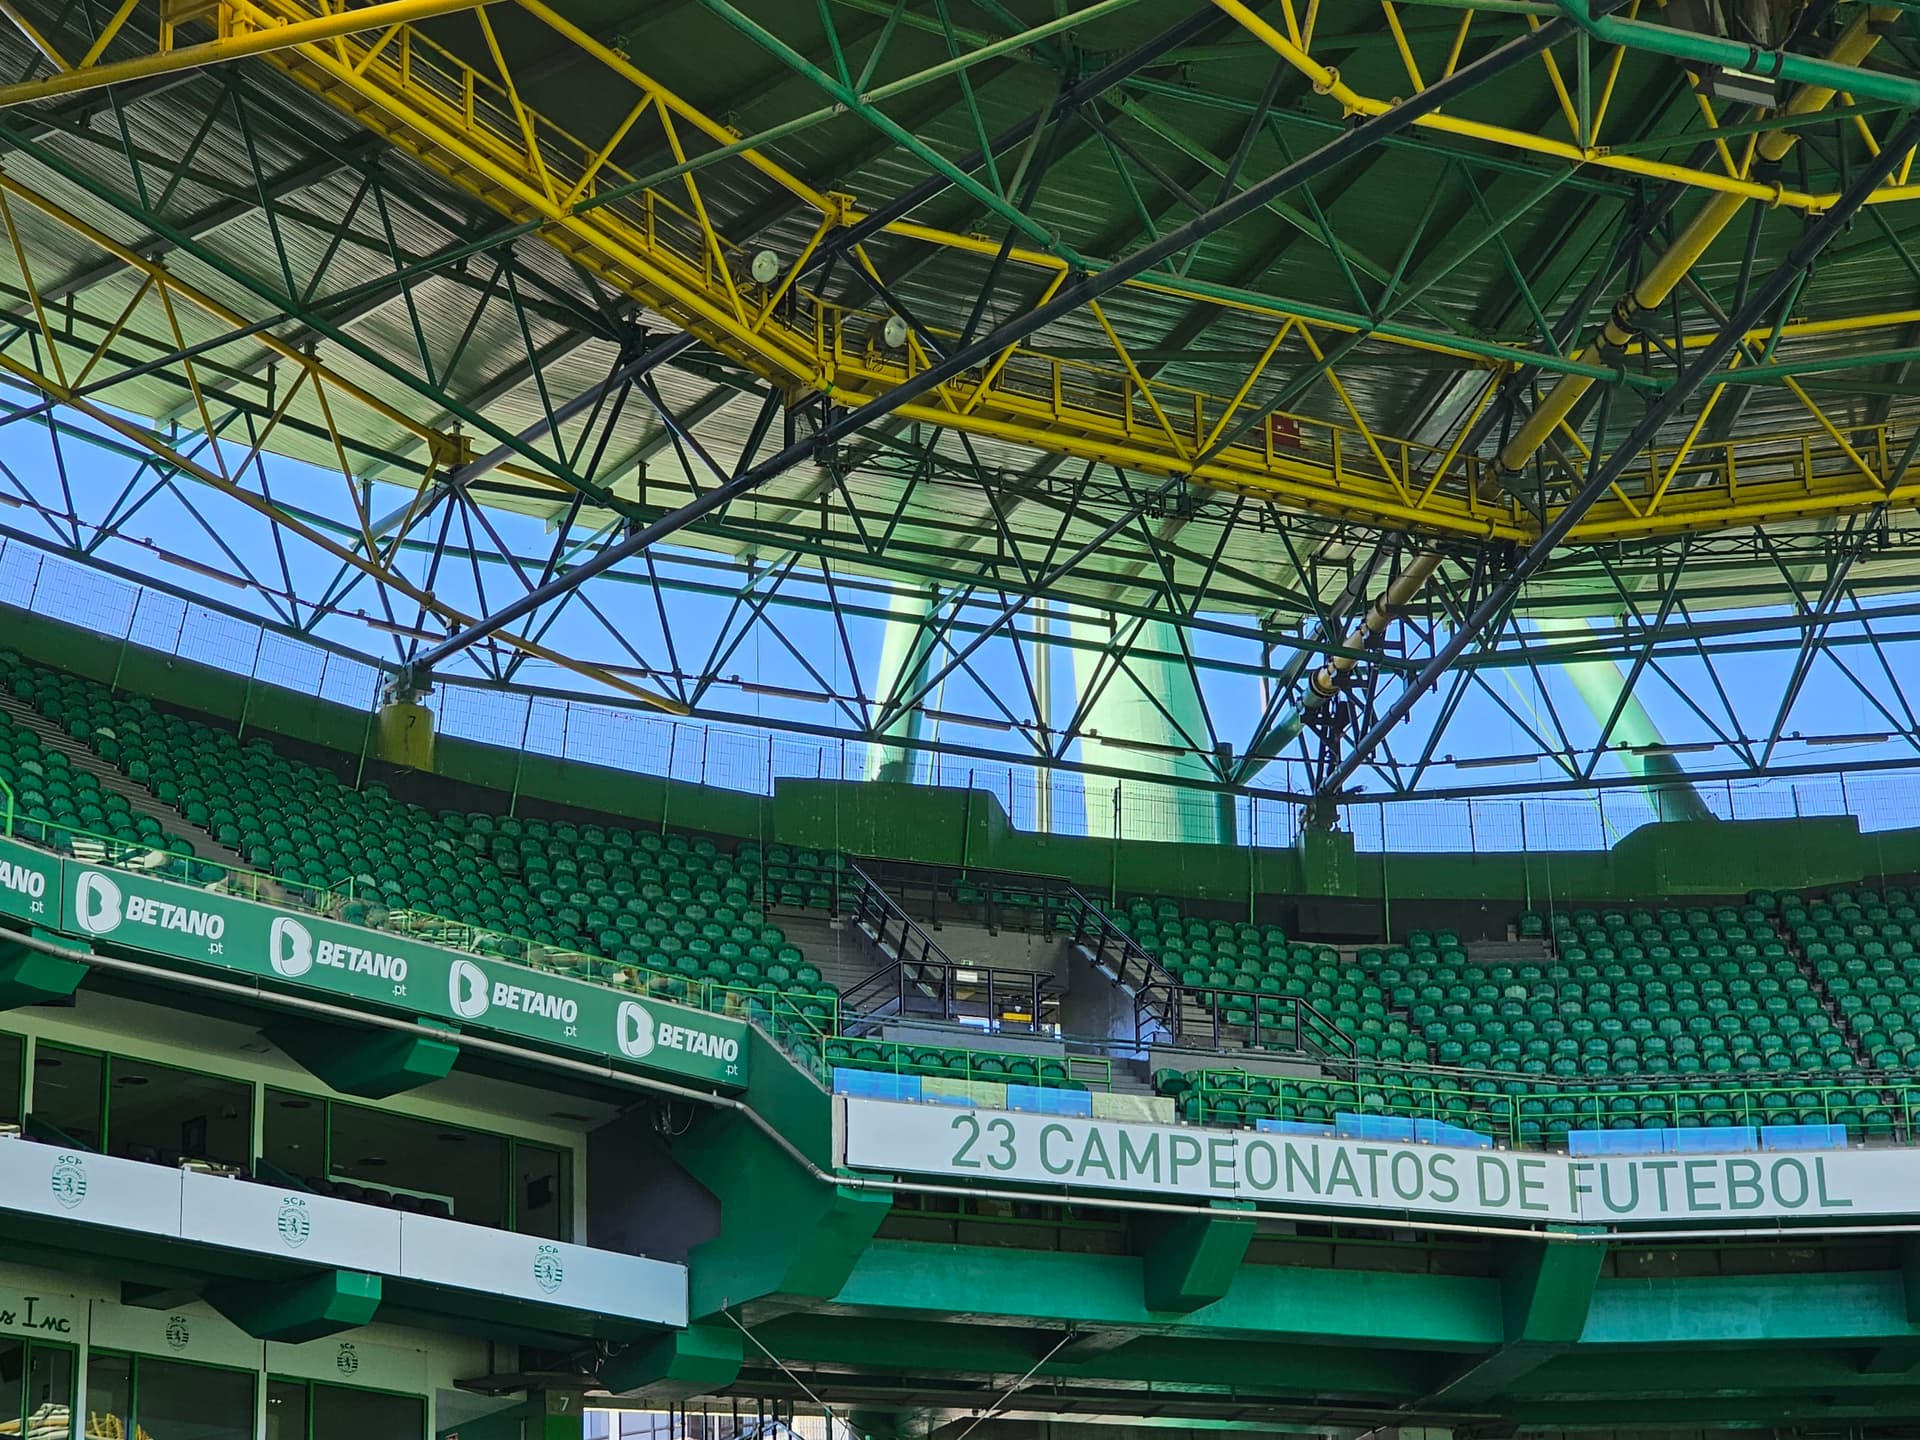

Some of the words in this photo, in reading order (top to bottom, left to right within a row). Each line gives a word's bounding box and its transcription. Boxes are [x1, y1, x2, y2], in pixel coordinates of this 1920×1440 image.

[0, 859, 45, 897] ANO
[126, 896, 224, 939] BETANO
[316, 940, 408, 982] BETANO
[492, 982, 578, 1023] BETANO
[657, 1023, 739, 1062] BETANO
[58, 1155, 83, 1165] SCP
[951, 1115, 1017, 1171] 23
[1039, 1123, 1460, 1202] CAMPEONATOS
[1477, 1156, 1549, 1211] DE
[1568, 1156, 1853, 1214] FUTEBOL
[283, 1197, 305, 1206] SCP
[539, 1245, 558, 1253] SCP
[560, 1397, 569, 1411] 7
